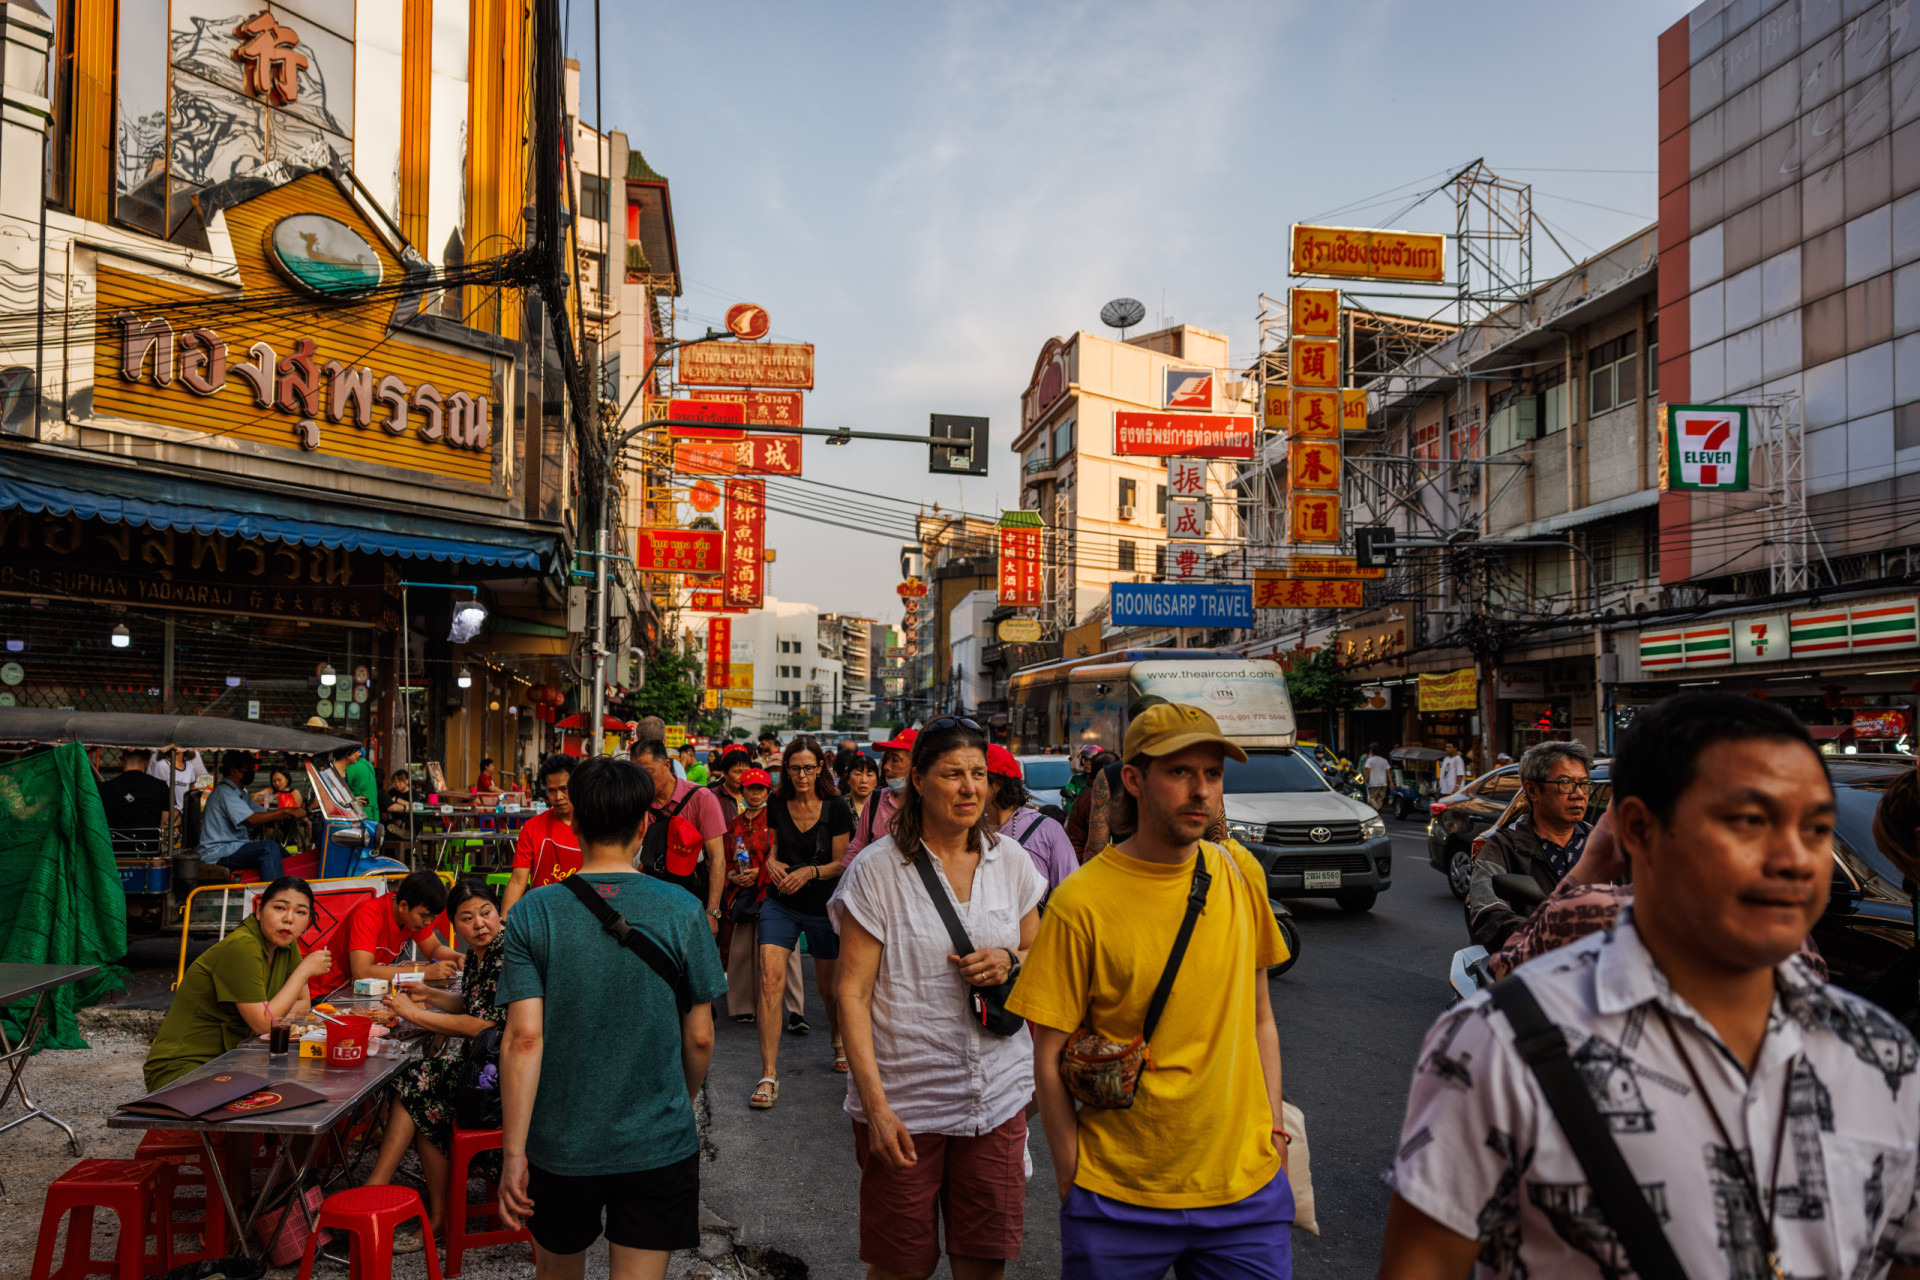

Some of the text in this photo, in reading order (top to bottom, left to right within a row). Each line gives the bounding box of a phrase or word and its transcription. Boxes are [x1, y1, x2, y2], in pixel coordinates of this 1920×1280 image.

[231, 10, 308, 105] 行
[111, 310, 491, 451] ทองสุพรรณ
[688, 367, 806, 382] CHINA TOWN SCALA
[1298, 297, 1334, 534] 汕頭長春酒
[1172, 464, 1205, 579] 振成豐
[50, 570, 128, 597] SUPHAN
[1004, 532, 1017, 601] 中國大酒店
[1026, 535, 1036, 601] HOTEL
[1116, 592, 1196, 616] ROONGSARP
[1201, 595, 1249, 617] TRAVEL
[1147, 669, 1275, 680] www.theaircond.com
[334, 1047, 361, 1059] LEO
